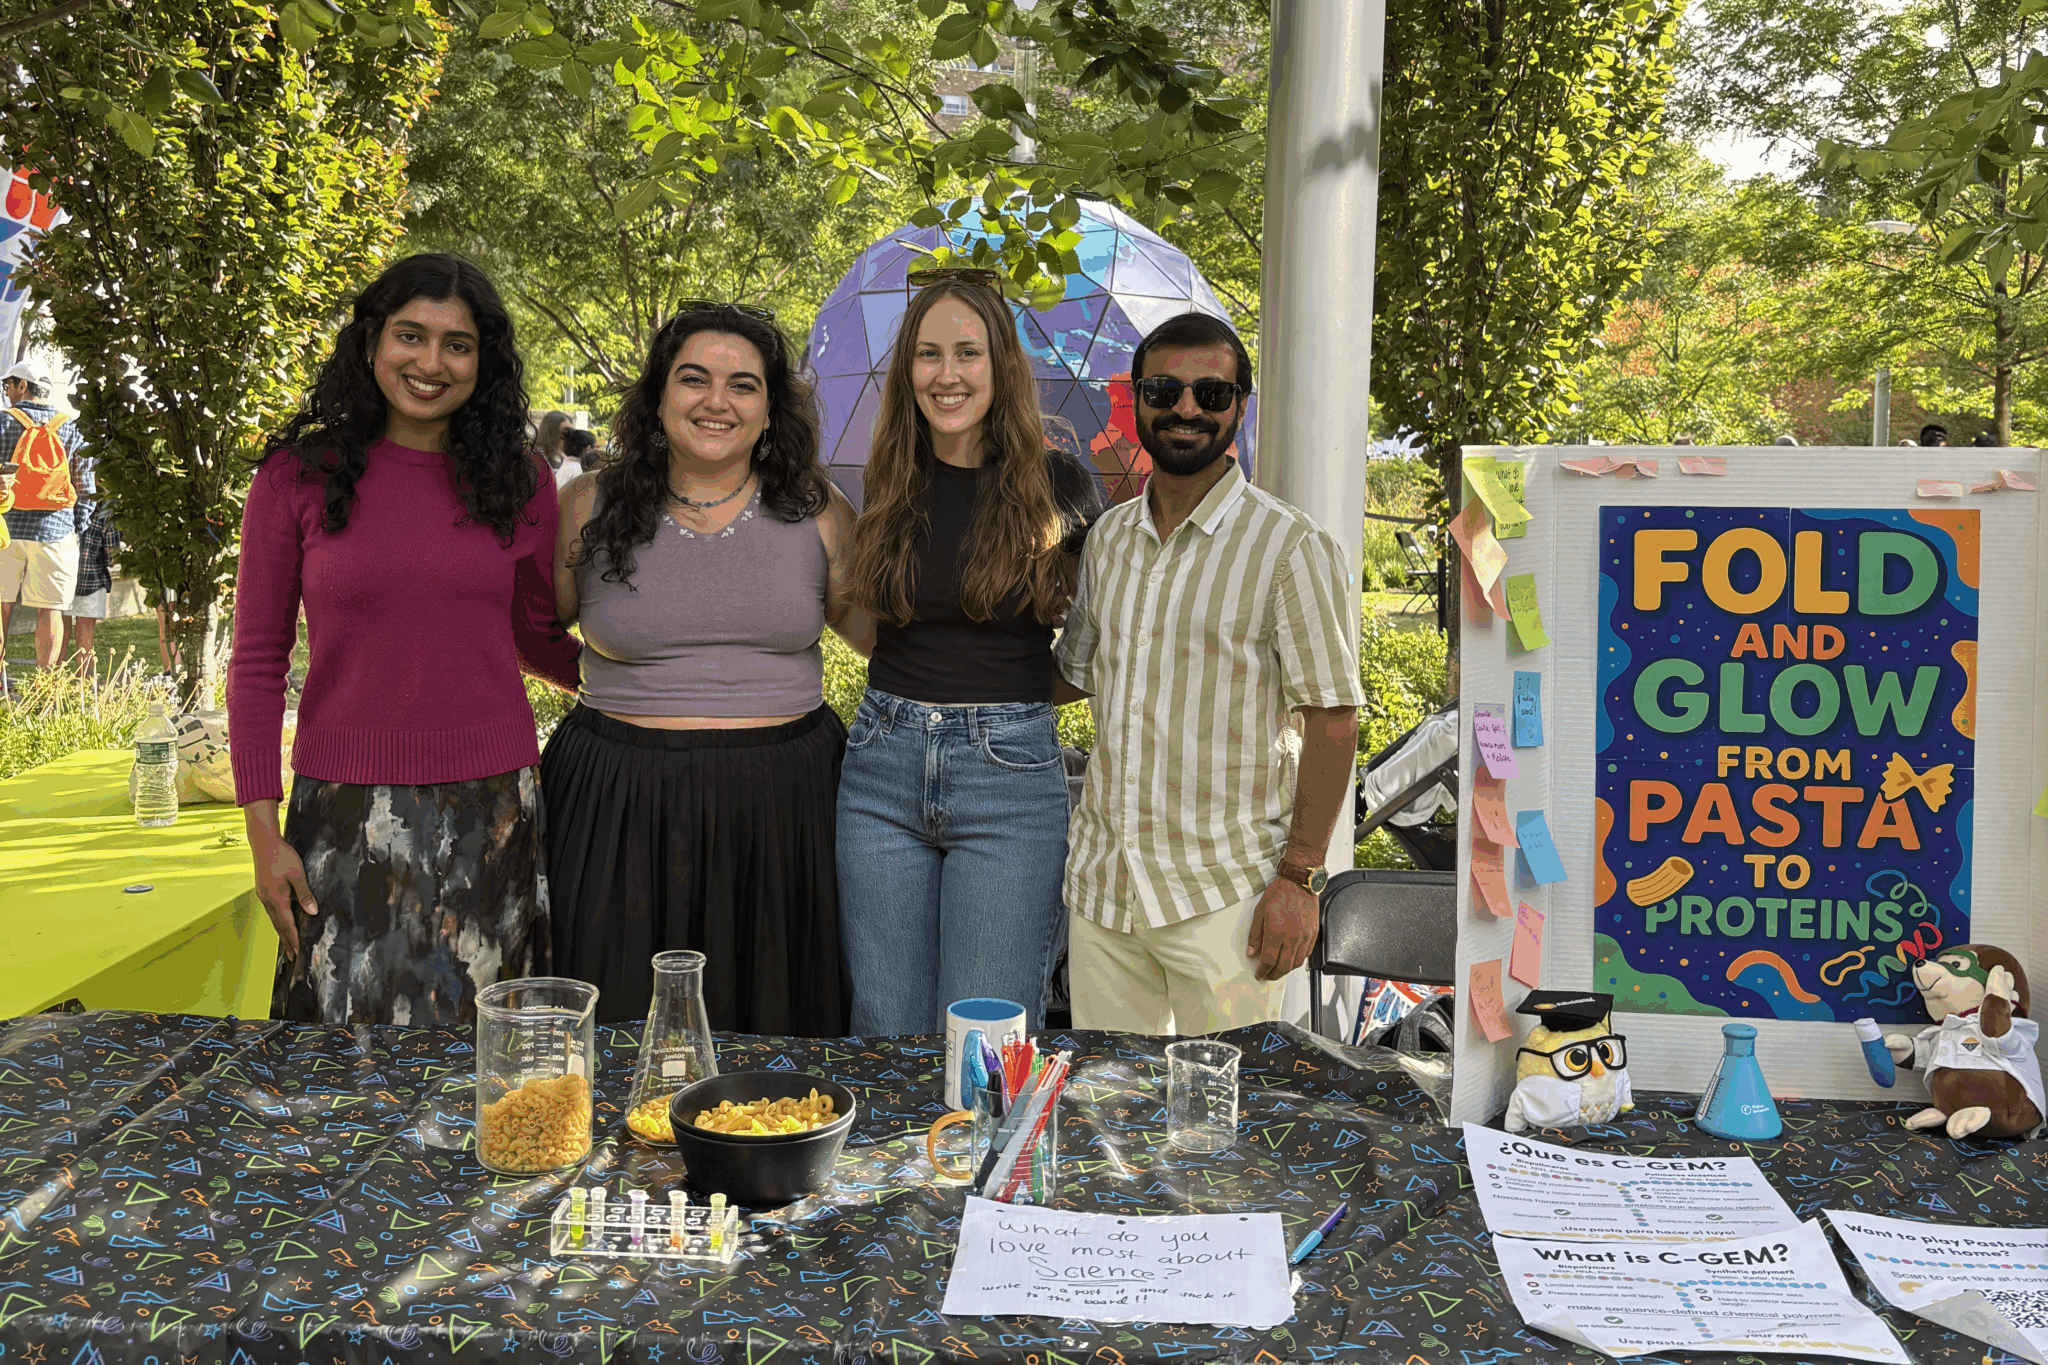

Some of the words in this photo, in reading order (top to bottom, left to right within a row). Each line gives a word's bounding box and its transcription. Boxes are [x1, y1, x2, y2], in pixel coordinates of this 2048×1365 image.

[1633, 527, 1939, 615] FOLD
[1730, 623, 1846, 660] AND
[1633, 658, 1941, 736] GLOW
[1717, 745, 1851, 780] FROM
[1629, 779, 1921, 851] PASTA
[1743, 854, 1811, 889] TO
[1645, 895, 1904, 942] PROTEINS
[1500, 1142, 1567, 1162] ¿Que
[1575, 1158, 1604, 1167] es
[1612, 1160, 1727, 1171] C-GEM?
[998, 1221, 1091, 1236] What
[1107, 1231, 1139, 1242] do
[1161, 1232, 1210, 1251] you
[1844, 1223, 1892, 1239] Want
[1896, 1233, 1916, 1241] to
[1920, 1236, 1959, 1247] play
[990, 1237, 1051, 1254] love
[1071, 1246, 1143, 1260] most
[1157, 1247, 1253, 1264] about
[1532, 1247, 1616, 1262] What
[1623, 1250, 1651, 1263] is
[1658, 1243, 1789, 1265] C-GEM?
[1926, 1247, 1945, 1255] at
[1948, 1248, 2010, 1257] home?
[982, 1283, 1021, 1291] write
[1075, 1288, 1101, 1296] post
[1891, 1271, 1926, 1279] Scan
[1047, 1294, 1071, 1302] the
[1605, 1306, 1718, 1316] sequence-defined
[1722, 1310, 1779, 1318] chemical
